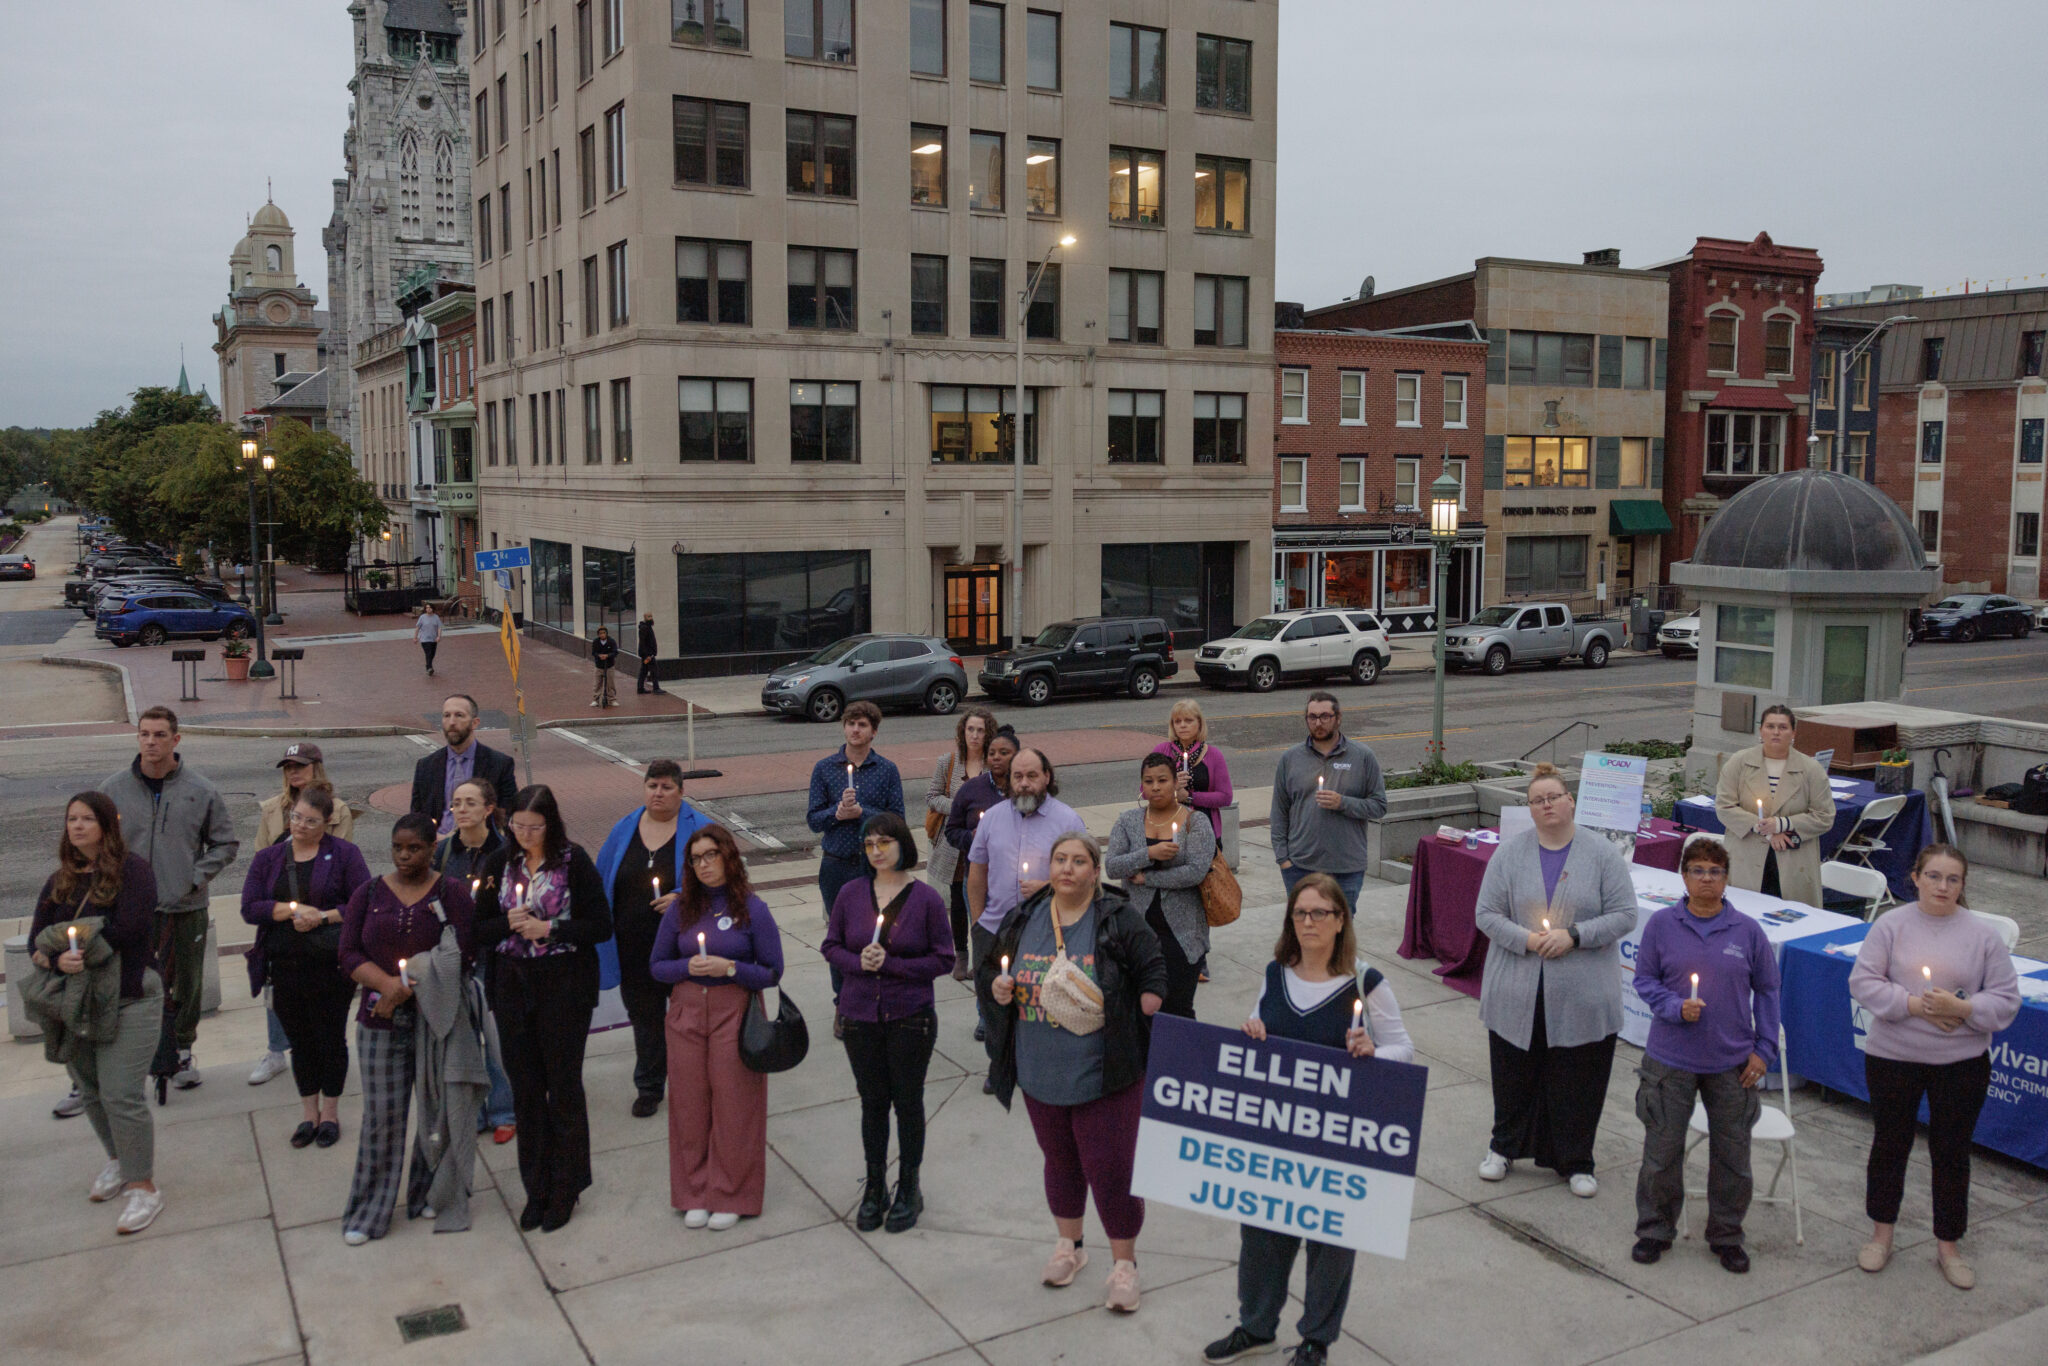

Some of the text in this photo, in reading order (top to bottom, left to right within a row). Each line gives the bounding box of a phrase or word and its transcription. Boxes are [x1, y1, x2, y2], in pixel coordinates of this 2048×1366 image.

[1607, 759, 1631, 768] PCADV
[1216, 1043, 1351, 1099] ELLEN
[1152, 1075, 1411, 1157] GREENBERG
[1178, 1136, 1368, 1201] DESERVES
[1189, 1180, 1345, 1237] JUSTICE
